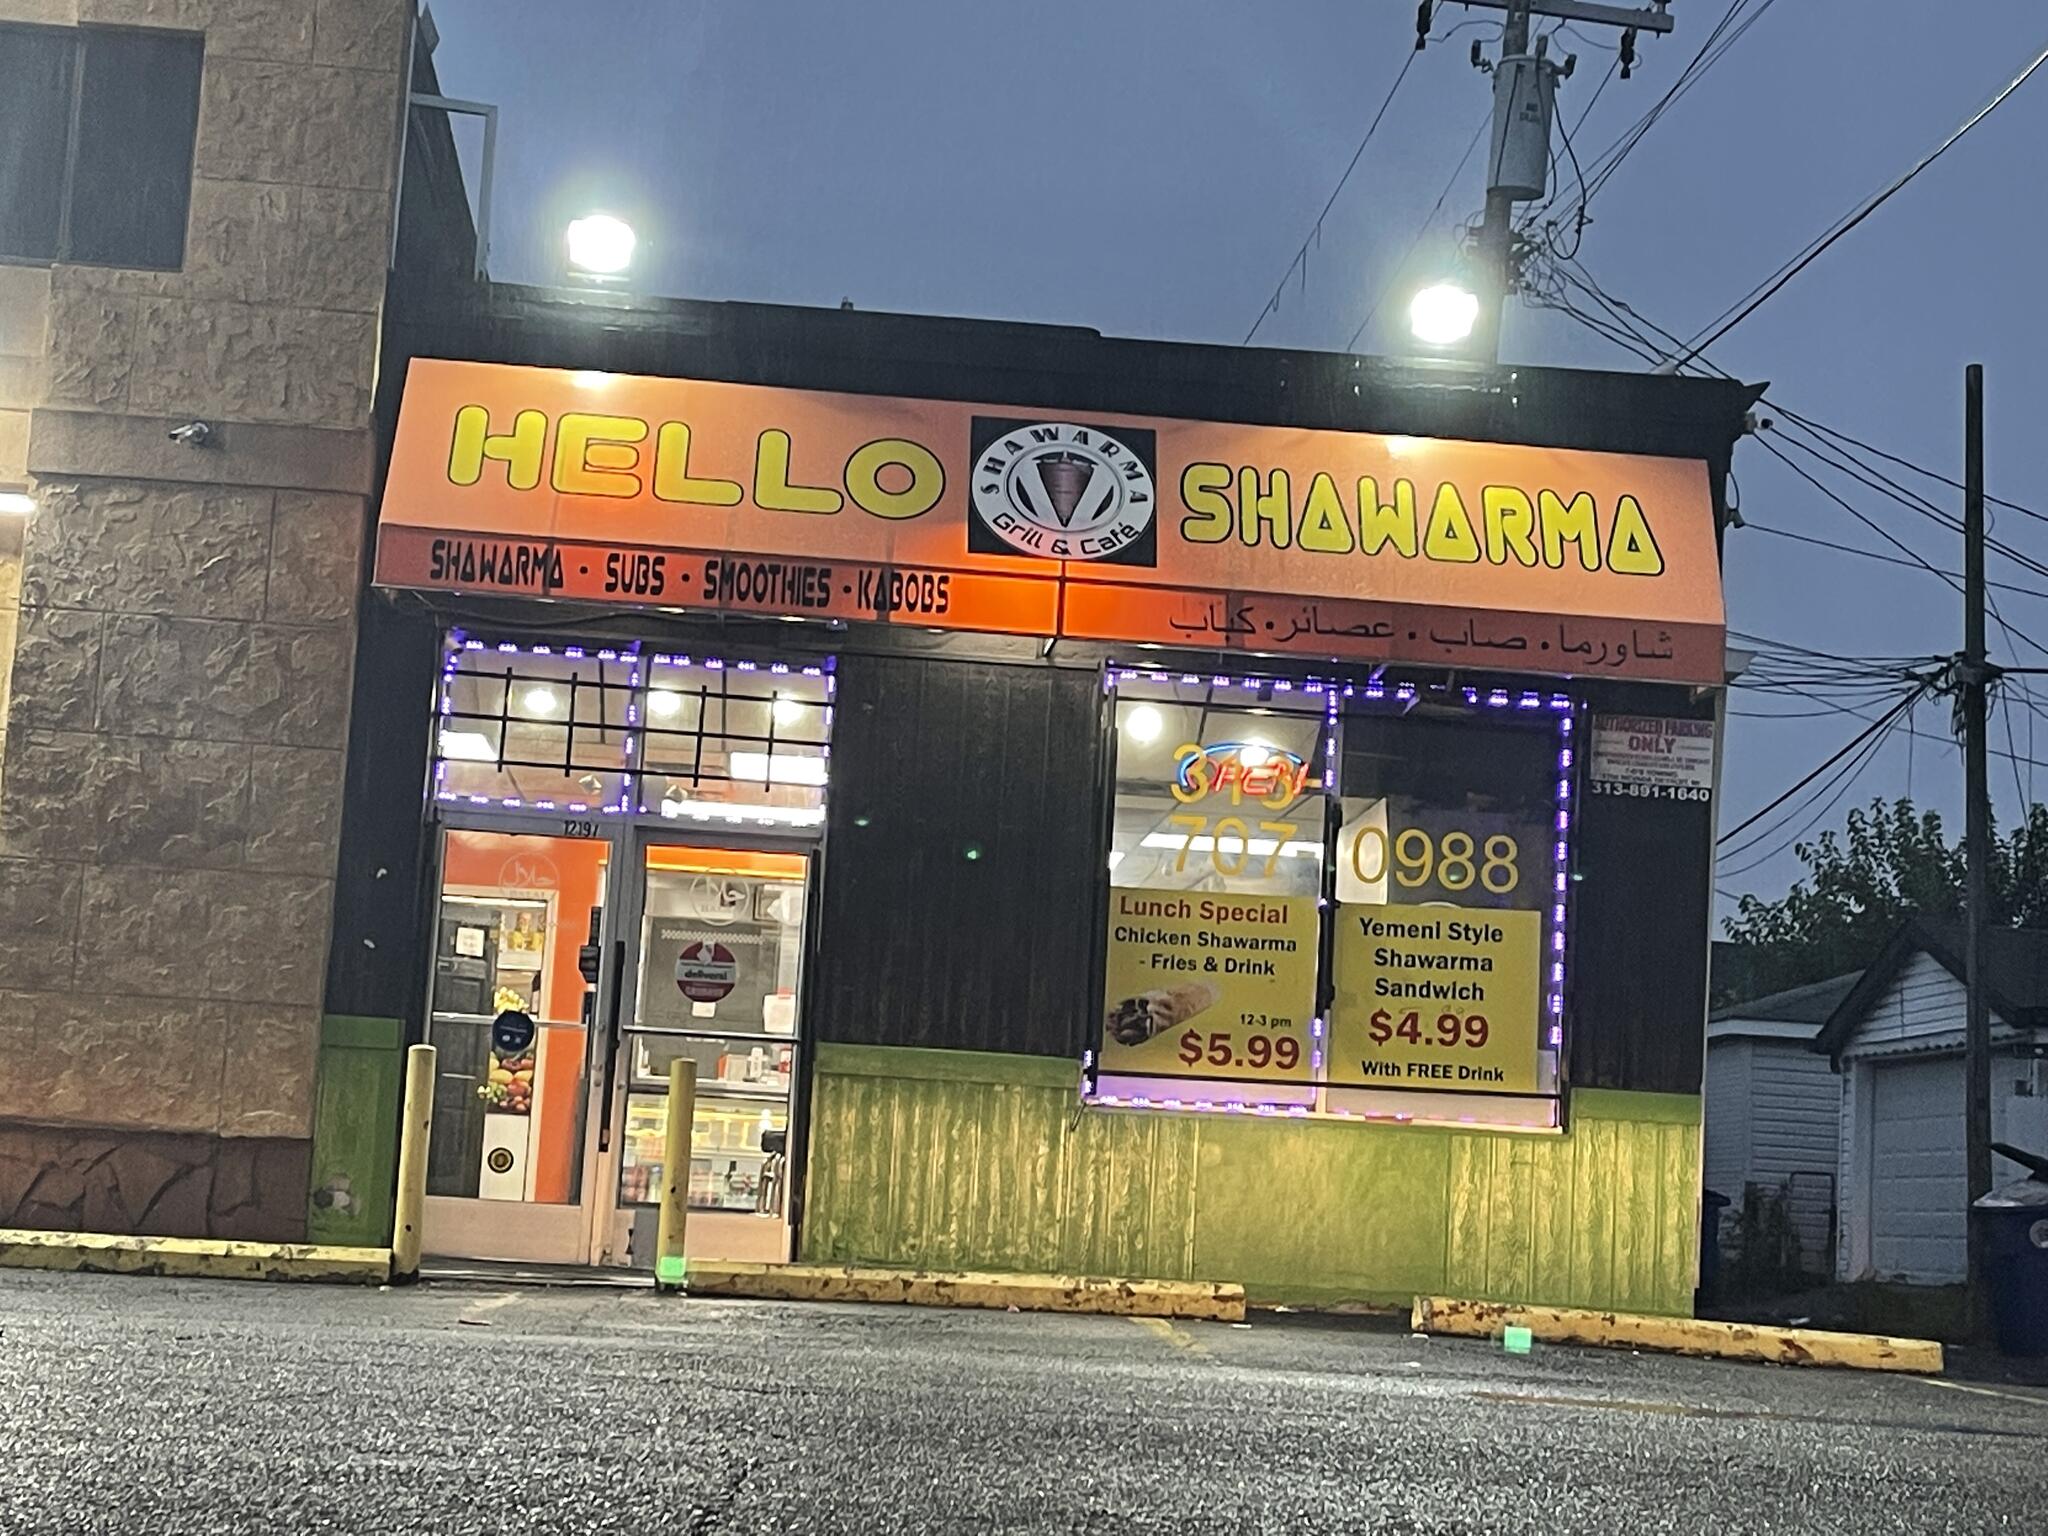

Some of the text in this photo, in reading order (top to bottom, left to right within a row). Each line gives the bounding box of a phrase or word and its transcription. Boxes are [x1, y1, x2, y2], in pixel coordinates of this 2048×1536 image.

[447, 404, 945, 519] HELLO
[980, 425, 1149, 504] SHAWARMA
[992, 512, 1043, 549] Grill
[1080, 522, 1138, 554] Café
[1180, 462, 1664, 576] SHAWARMA
[430, 539, 950, 613] SHAWARMA SUBS SMOOTHIES KABOBS
[1169, 604, 1256, 642] كباب
[1559, 623, 1673, 667] شاورما
[1628, 735, 1676, 753] ONLY
[1592, 781, 1709, 802] 313-891-1640
[1169, 815, 1519, 893] 707 0988
[1120, 895, 1287, 924] Lunch Special
[1114, 926, 1296, 952] Chicken Shawarma
[1360, 917, 1503, 945] Yemeni Style
[1151, 953, 1197, 971] Fries
[1203, 956, 1218, 972] &
[1225, 957, 1275, 975] Drink
[1374, 948, 1493, 972] Shawarma
[1375, 978, 1484, 1001] Sandwich
[1240, 1014, 1292, 1029] 12-3 pm
[1369, 1007, 1489, 1048] $4.99
[1179, 1028, 1299, 1069] $5.99
[1362, 1060, 1504, 1082] With FREE Drink
